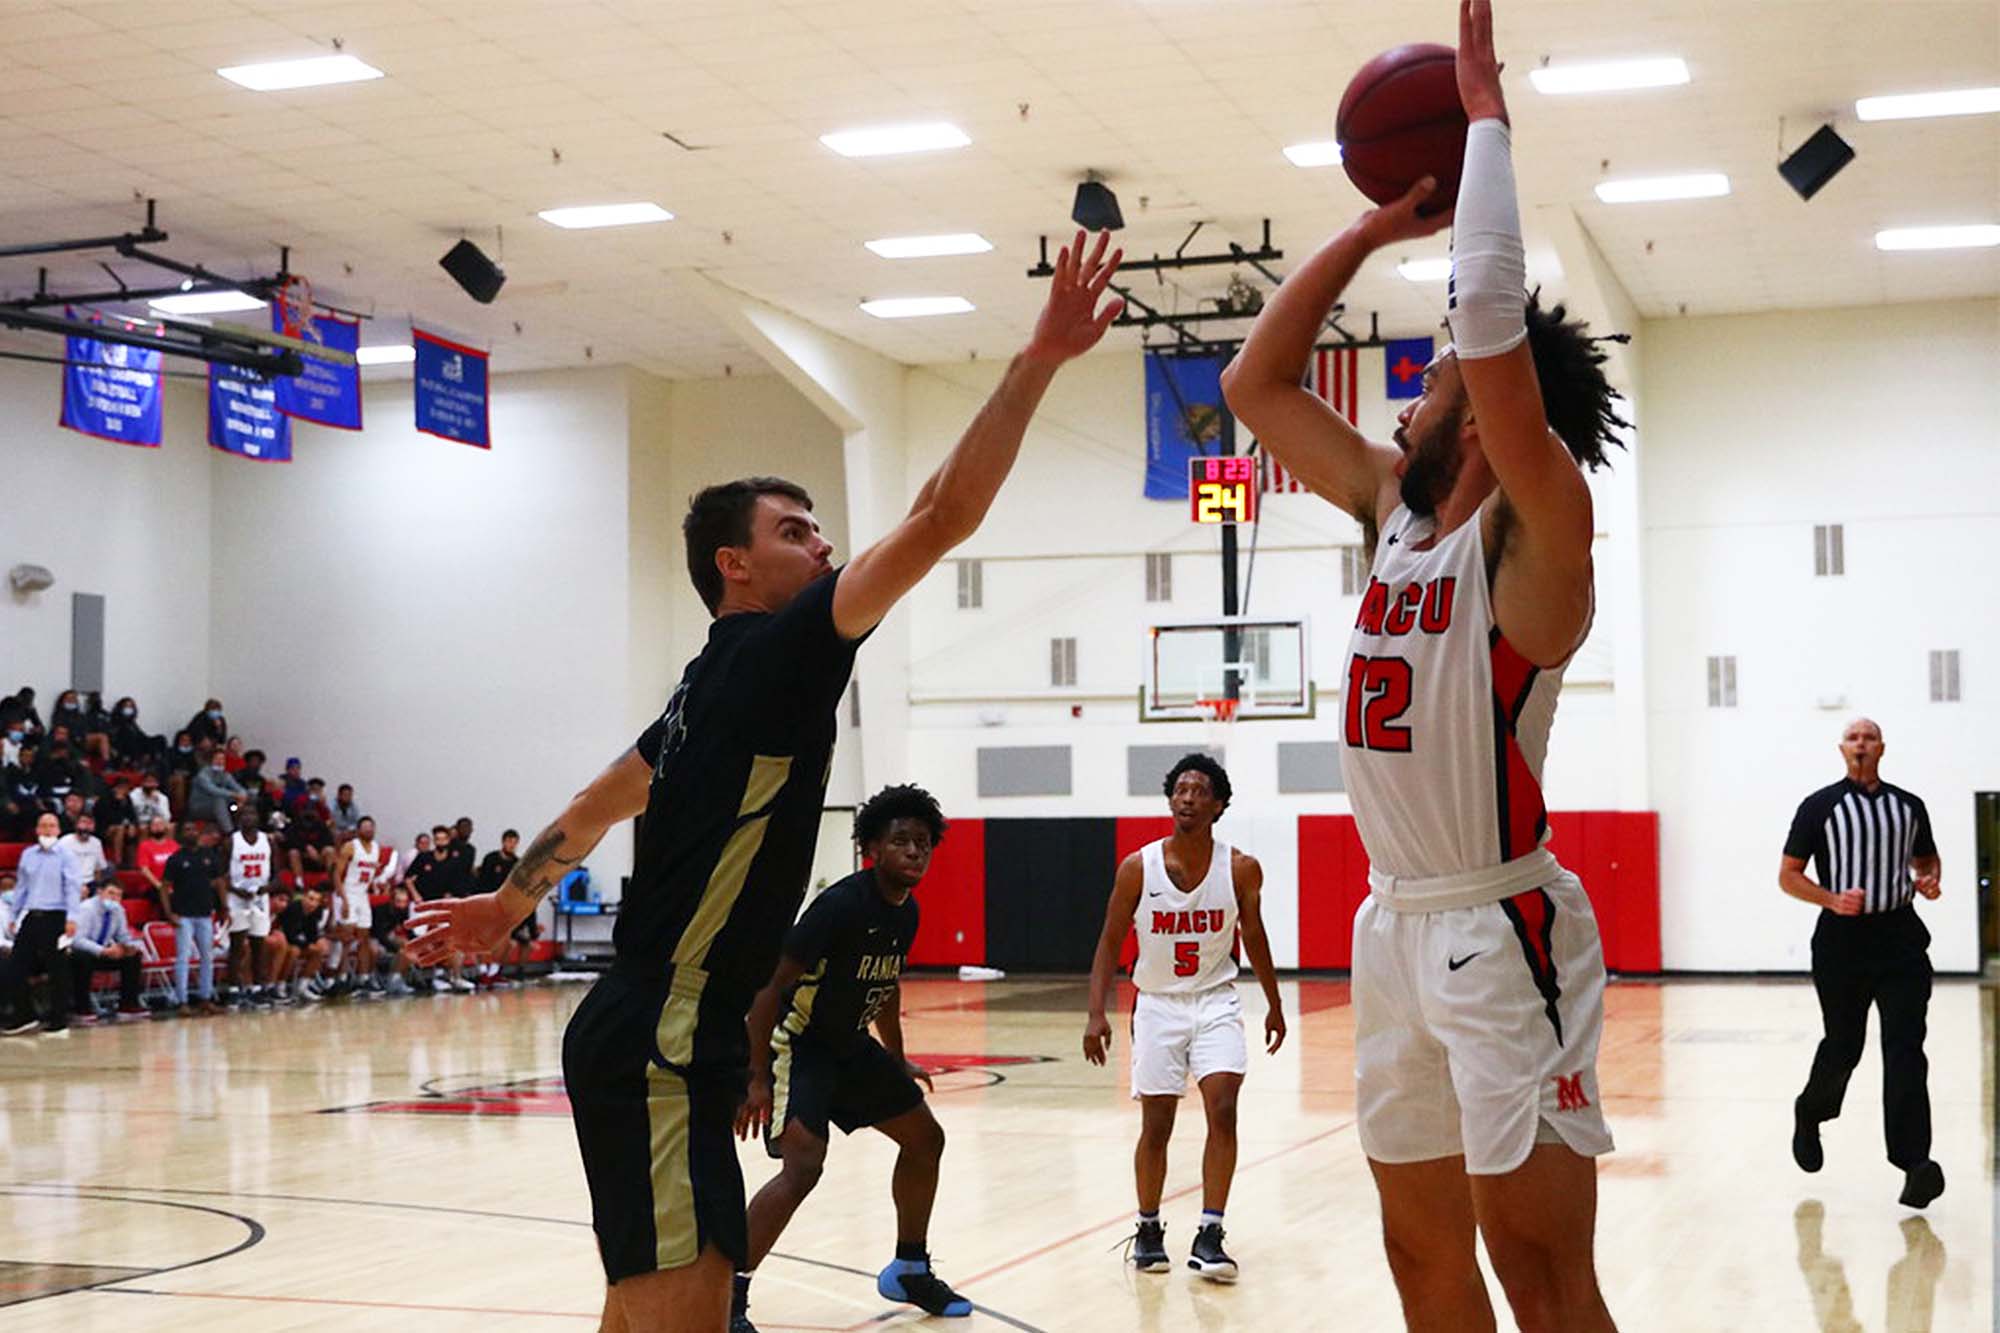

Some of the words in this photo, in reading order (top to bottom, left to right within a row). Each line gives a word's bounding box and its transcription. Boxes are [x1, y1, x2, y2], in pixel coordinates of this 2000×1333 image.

[1198, 483, 1246, 522] 24
[1345, 653, 1413, 753] 12
[1151, 909, 1225, 936] MACU
[1174, 942, 1200, 977] 5
[1549, 1070, 1590, 1113] M
